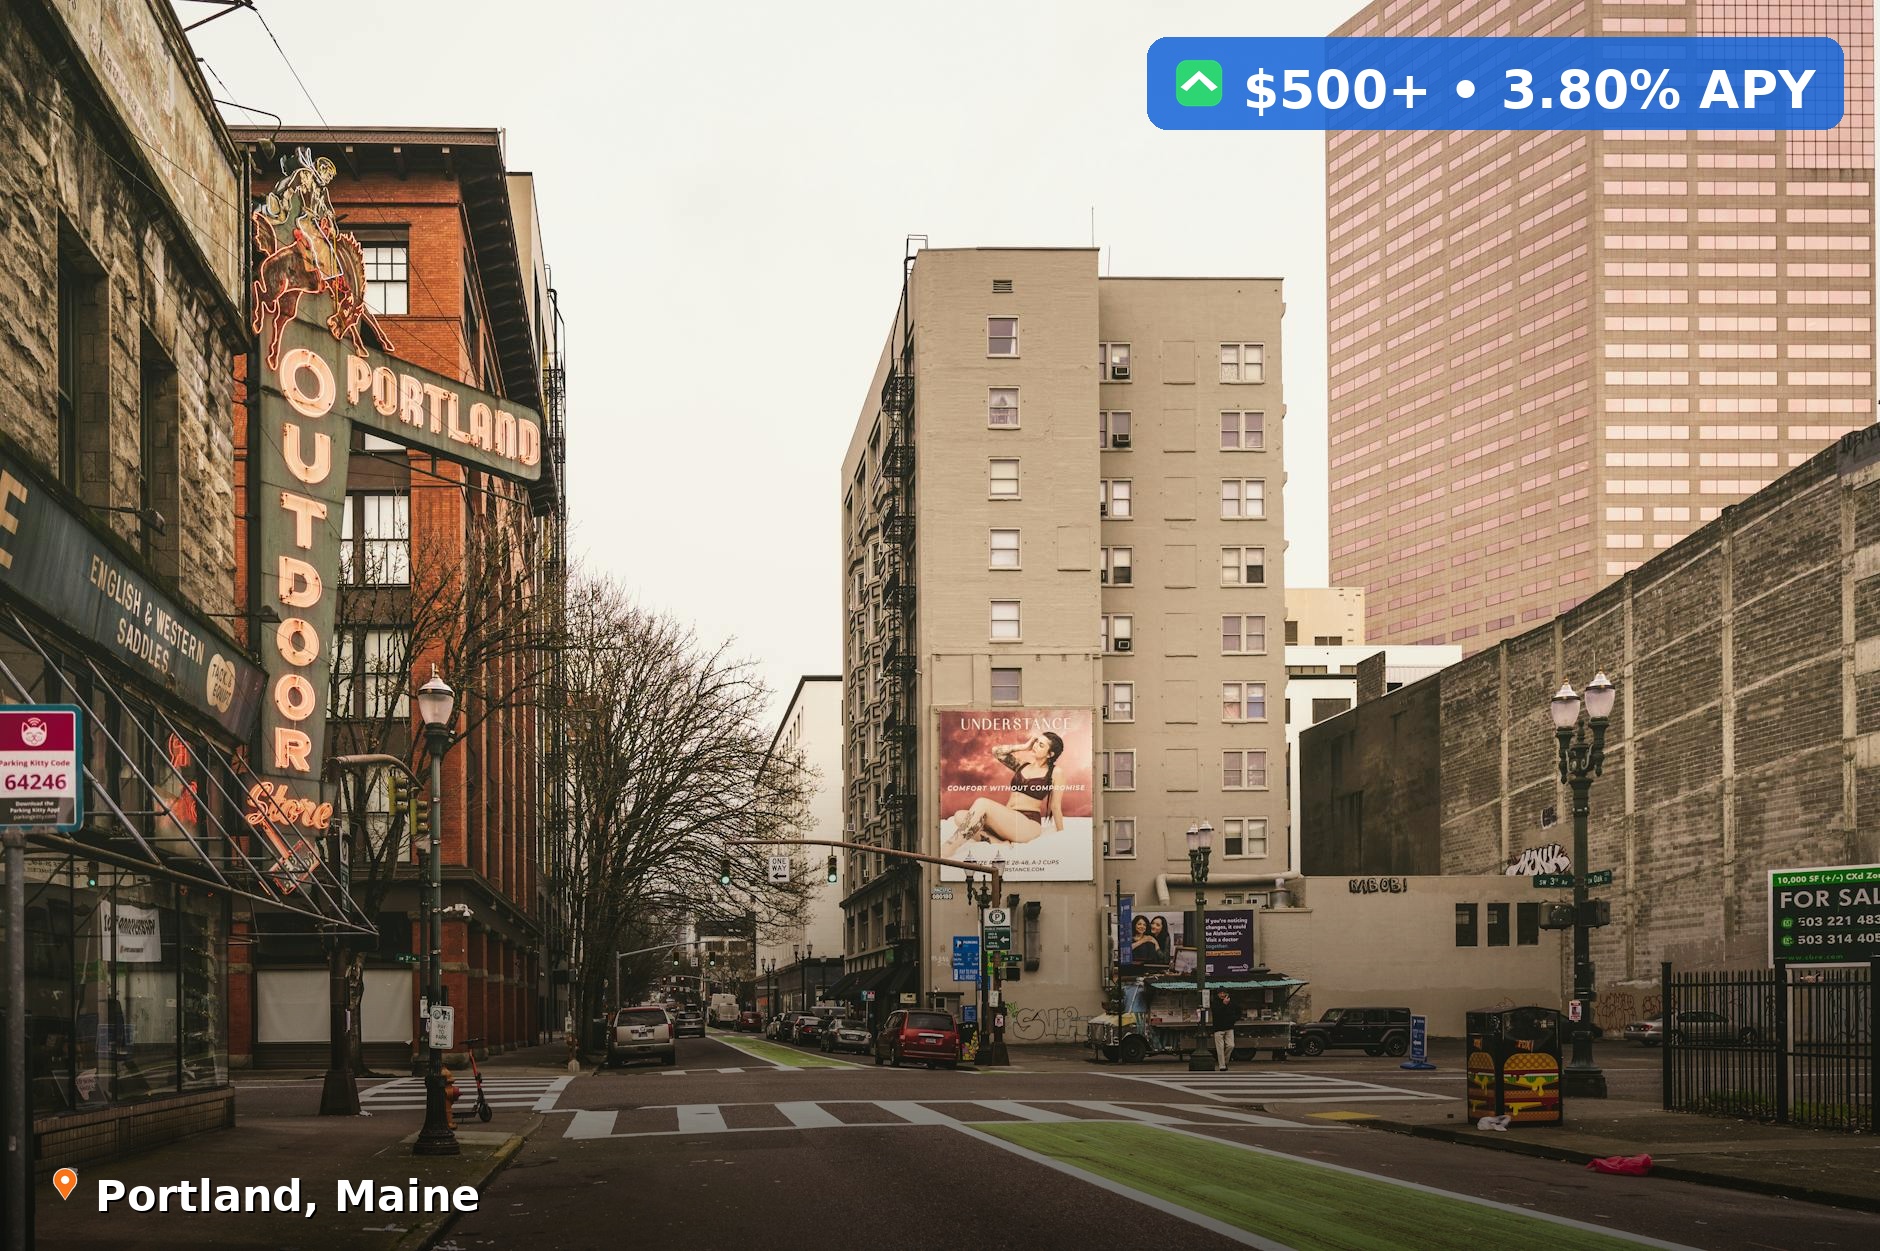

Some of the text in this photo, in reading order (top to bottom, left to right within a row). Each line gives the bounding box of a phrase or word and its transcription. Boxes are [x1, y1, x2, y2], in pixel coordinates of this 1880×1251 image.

[347, 354, 541, 466] PORTLAND
[274, 348, 336, 773] OUTDOOR
[90, 554, 205, 666] ENGLISH & WESTERN
[117, 618, 170, 673] SADDLES
[960, 718, 1072, 730] UNDERSTANCE
[0, 760, 28, 768] Parking
[30, 760, 49, 768] Kitty
[5, 774, 67, 790] 64246
[246, 782, 334, 830] Store
[1777, 876, 1807, 884] 10,000
[1780, 890, 1830, 909] FOR
[1798, 916, 1822, 927] 503
[1827, 916, 1851, 926] 221
[1798, 935, 1822, 945] 503
[1827, 934, 1852, 944] 314
